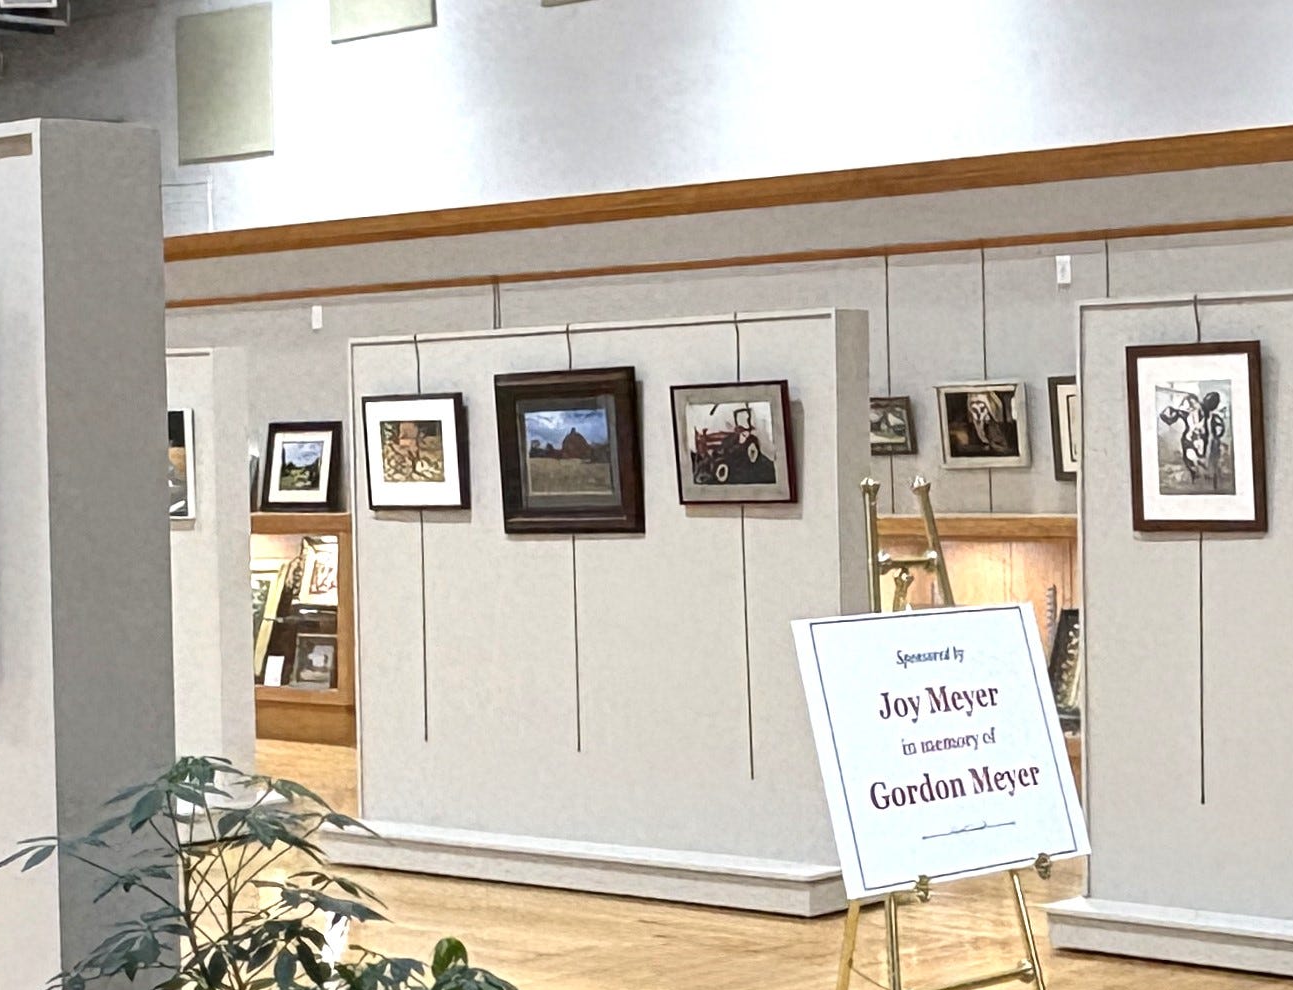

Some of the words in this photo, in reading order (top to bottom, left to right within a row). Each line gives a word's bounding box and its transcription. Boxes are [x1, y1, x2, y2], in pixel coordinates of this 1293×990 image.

[879, 691, 920, 724] Joy
[924, 685, 999, 717] Meyer
[901, 738, 917, 756] in
[921, 733, 979, 754] memory
[982, 726, 997, 744] of
[870, 772, 966, 810] Gordon
[968, 766, 1040, 797] Meyer
